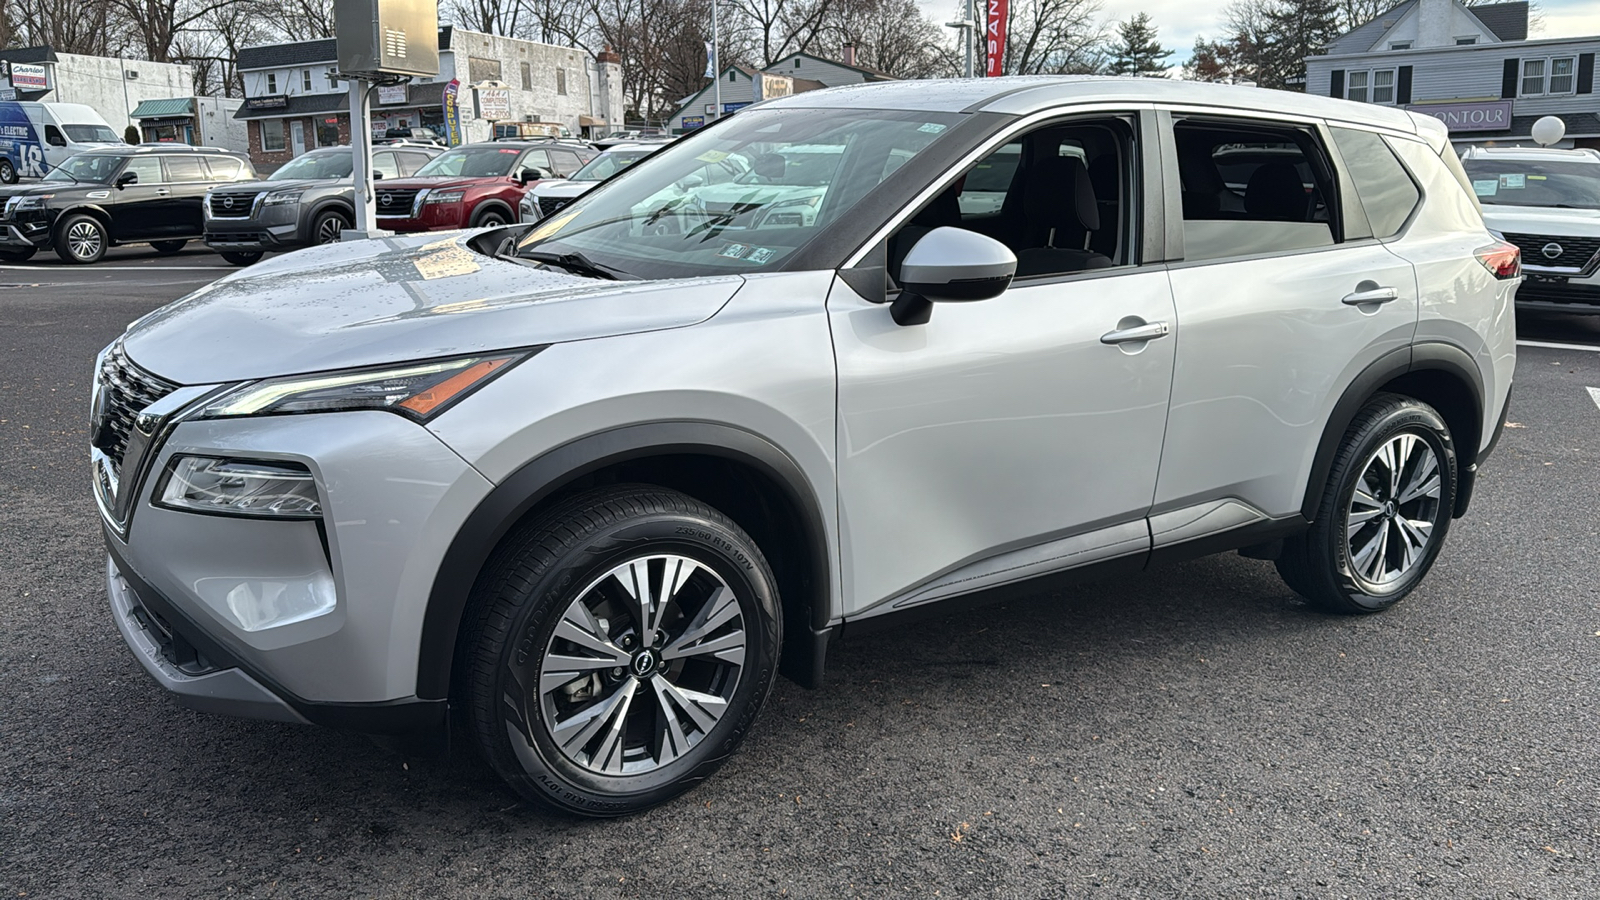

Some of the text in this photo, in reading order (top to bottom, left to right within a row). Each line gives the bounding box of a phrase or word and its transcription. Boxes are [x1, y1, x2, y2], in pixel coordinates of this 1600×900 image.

[4, 125, 28, 136] ELECTRIC
[675, 526, 754, 571] 235/60 R18 107V
